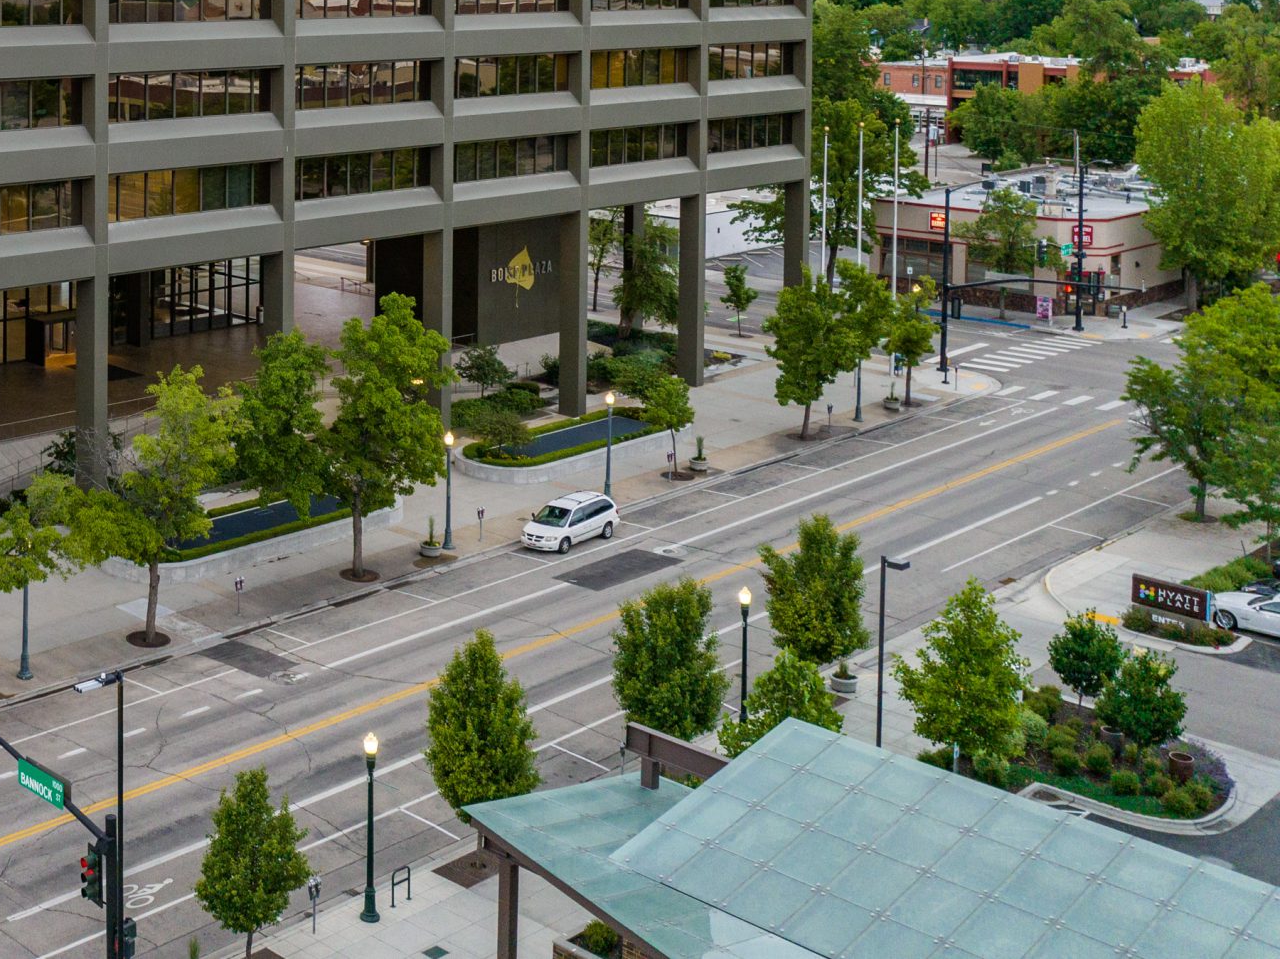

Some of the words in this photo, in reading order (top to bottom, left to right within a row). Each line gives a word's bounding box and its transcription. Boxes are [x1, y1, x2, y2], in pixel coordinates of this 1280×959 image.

[491, 266, 519, 282] BOISE
[521, 260, 553, 277] PLAZA
[1158, 588, 1200, 606] HYATT
[1158, 596, 1200, 613] PLACE
[20, 771, 53, 802] BANNOCK
[55, 793, 61, 803] ST
